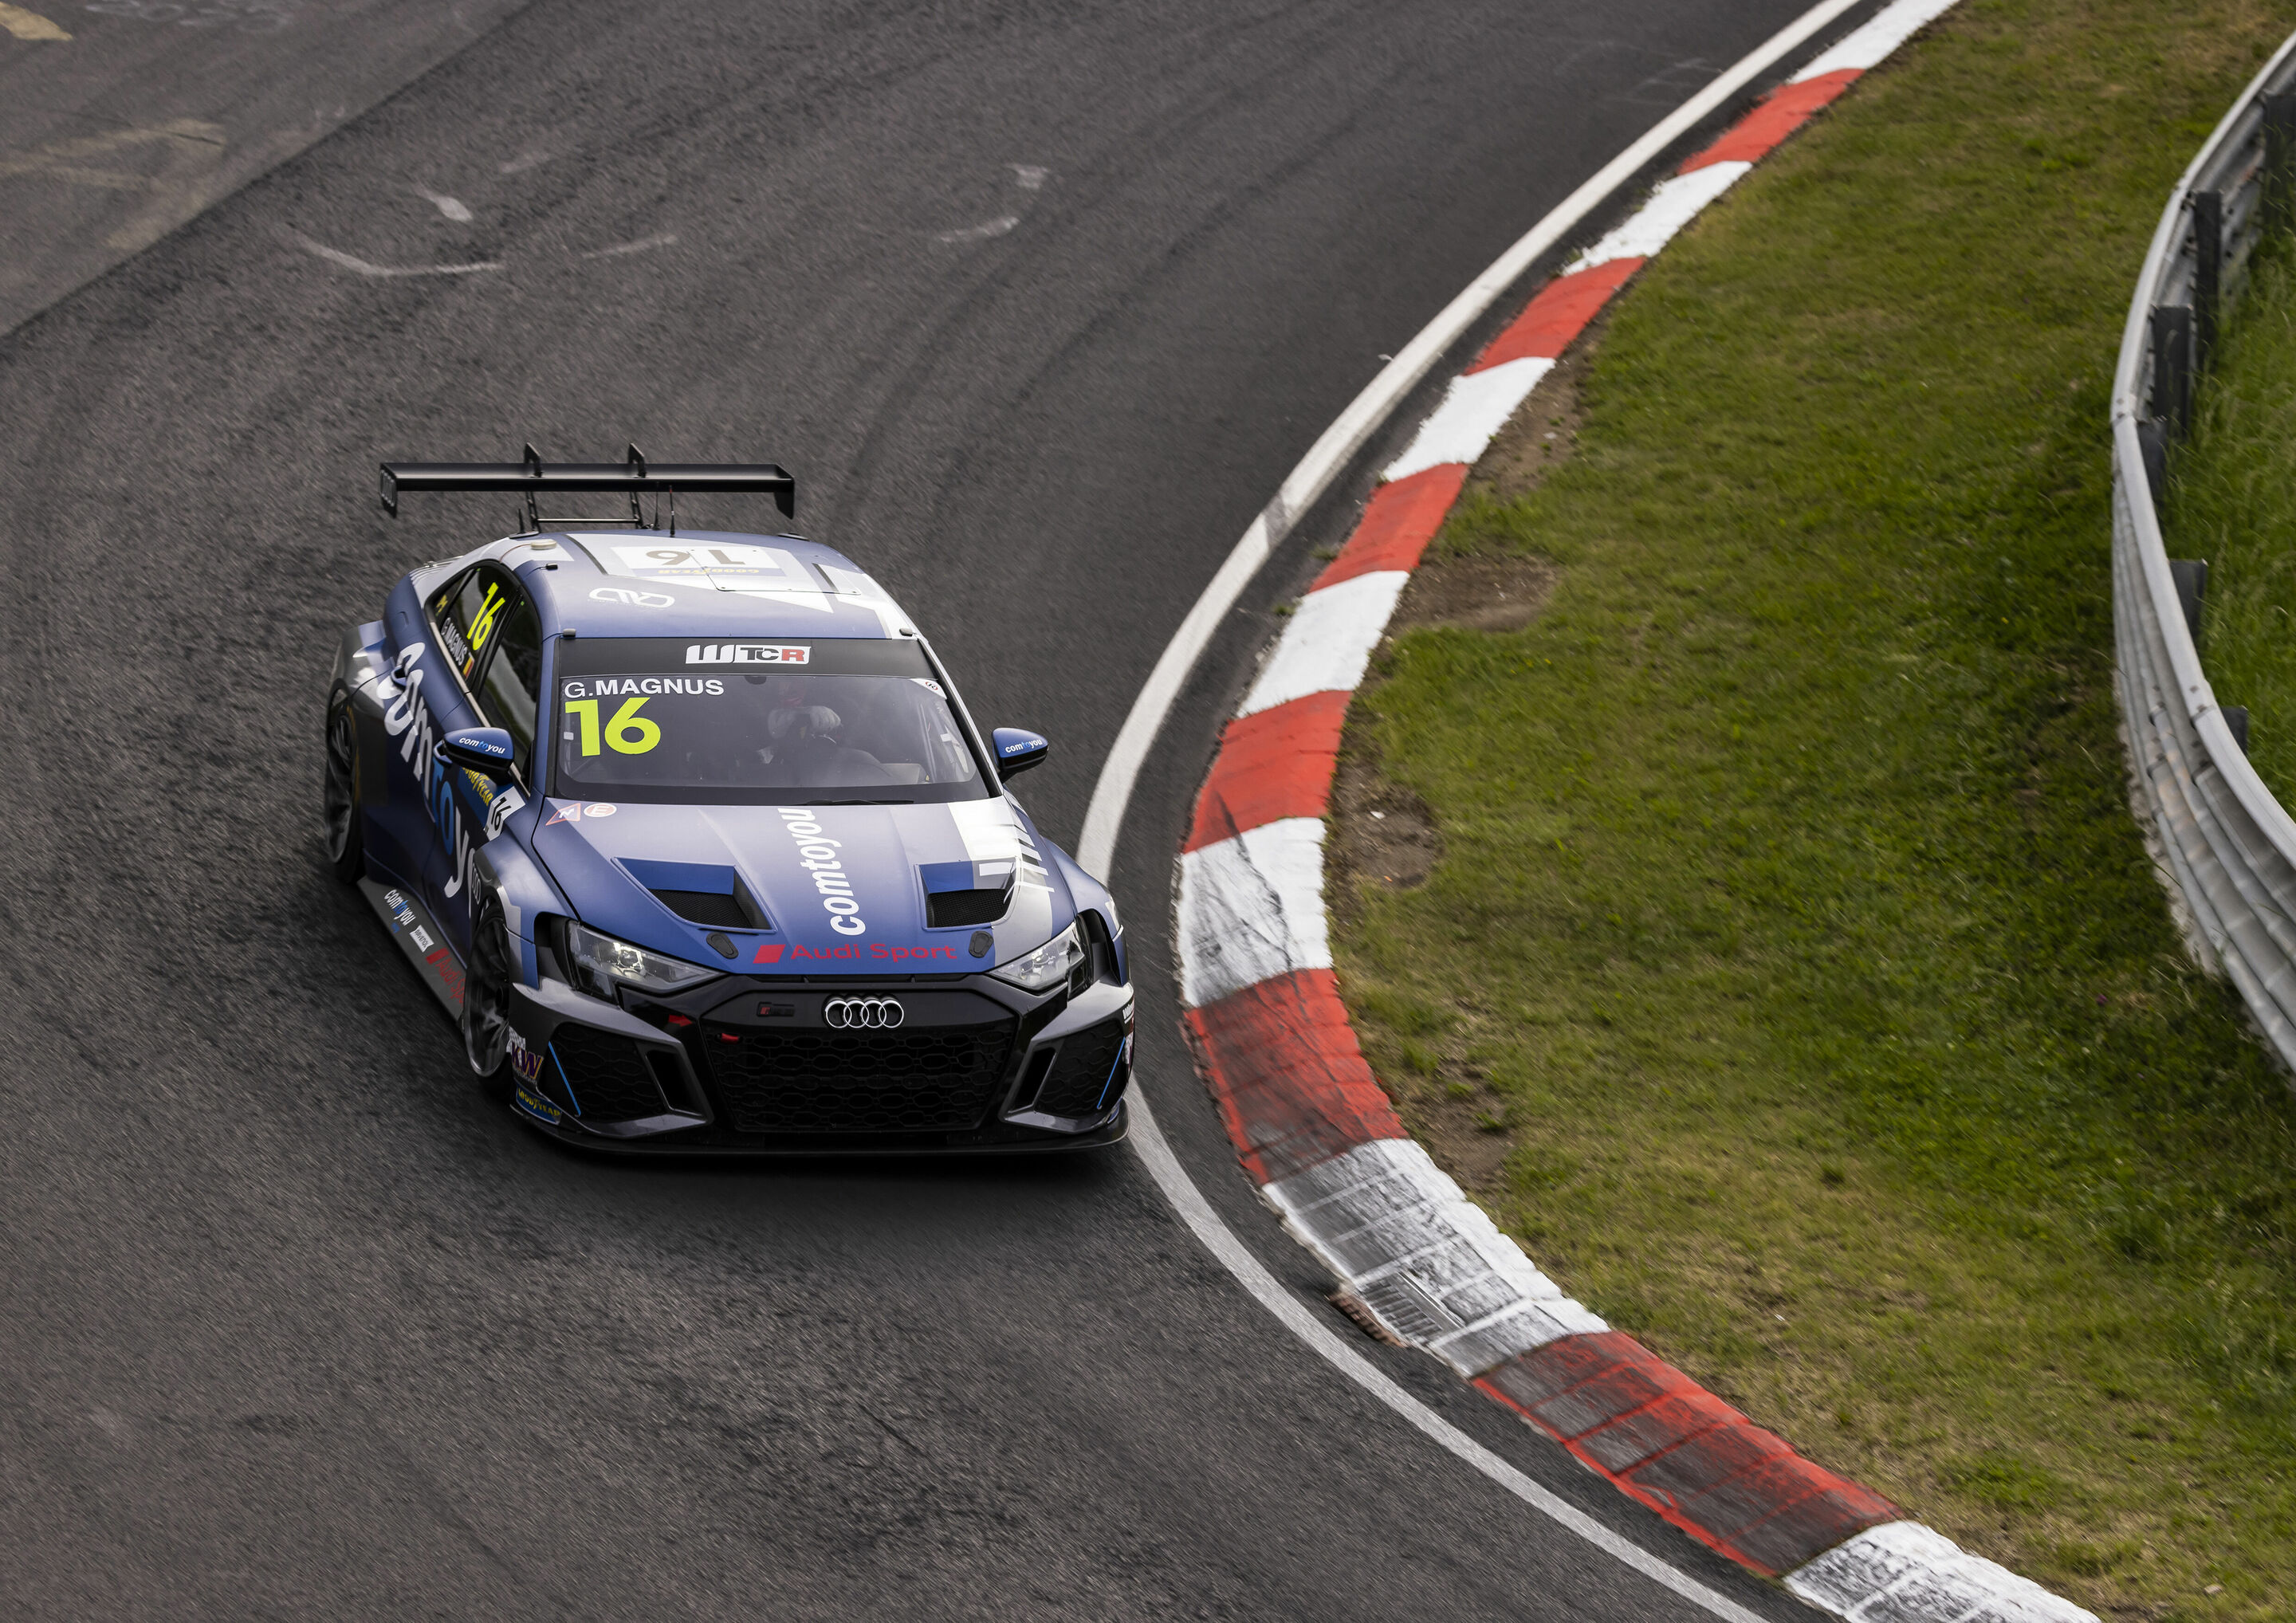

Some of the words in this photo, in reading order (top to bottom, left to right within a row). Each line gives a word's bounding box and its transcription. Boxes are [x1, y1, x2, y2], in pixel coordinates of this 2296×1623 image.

[646, 549, 745, 566] 16
[466, 582, 506, 650] 16
[564, 678, 725, 698] G.MAGNUS
[564, 697, 661, 757] 16
[458, 737, 505, 754] comtoyou
[1005, 738, 1044, 753] comtoyou
[491, 796, 512, 831] 16
[777, 807, 866, 937] comtoyou
[383, 889, 416, 926] comtoyou
[790, 944, 861, 960] Audi
[870, 943, 957, 963] Sport
[434, 957, 462, 986] Audi
[511, 1040, 545, 1079] KW
